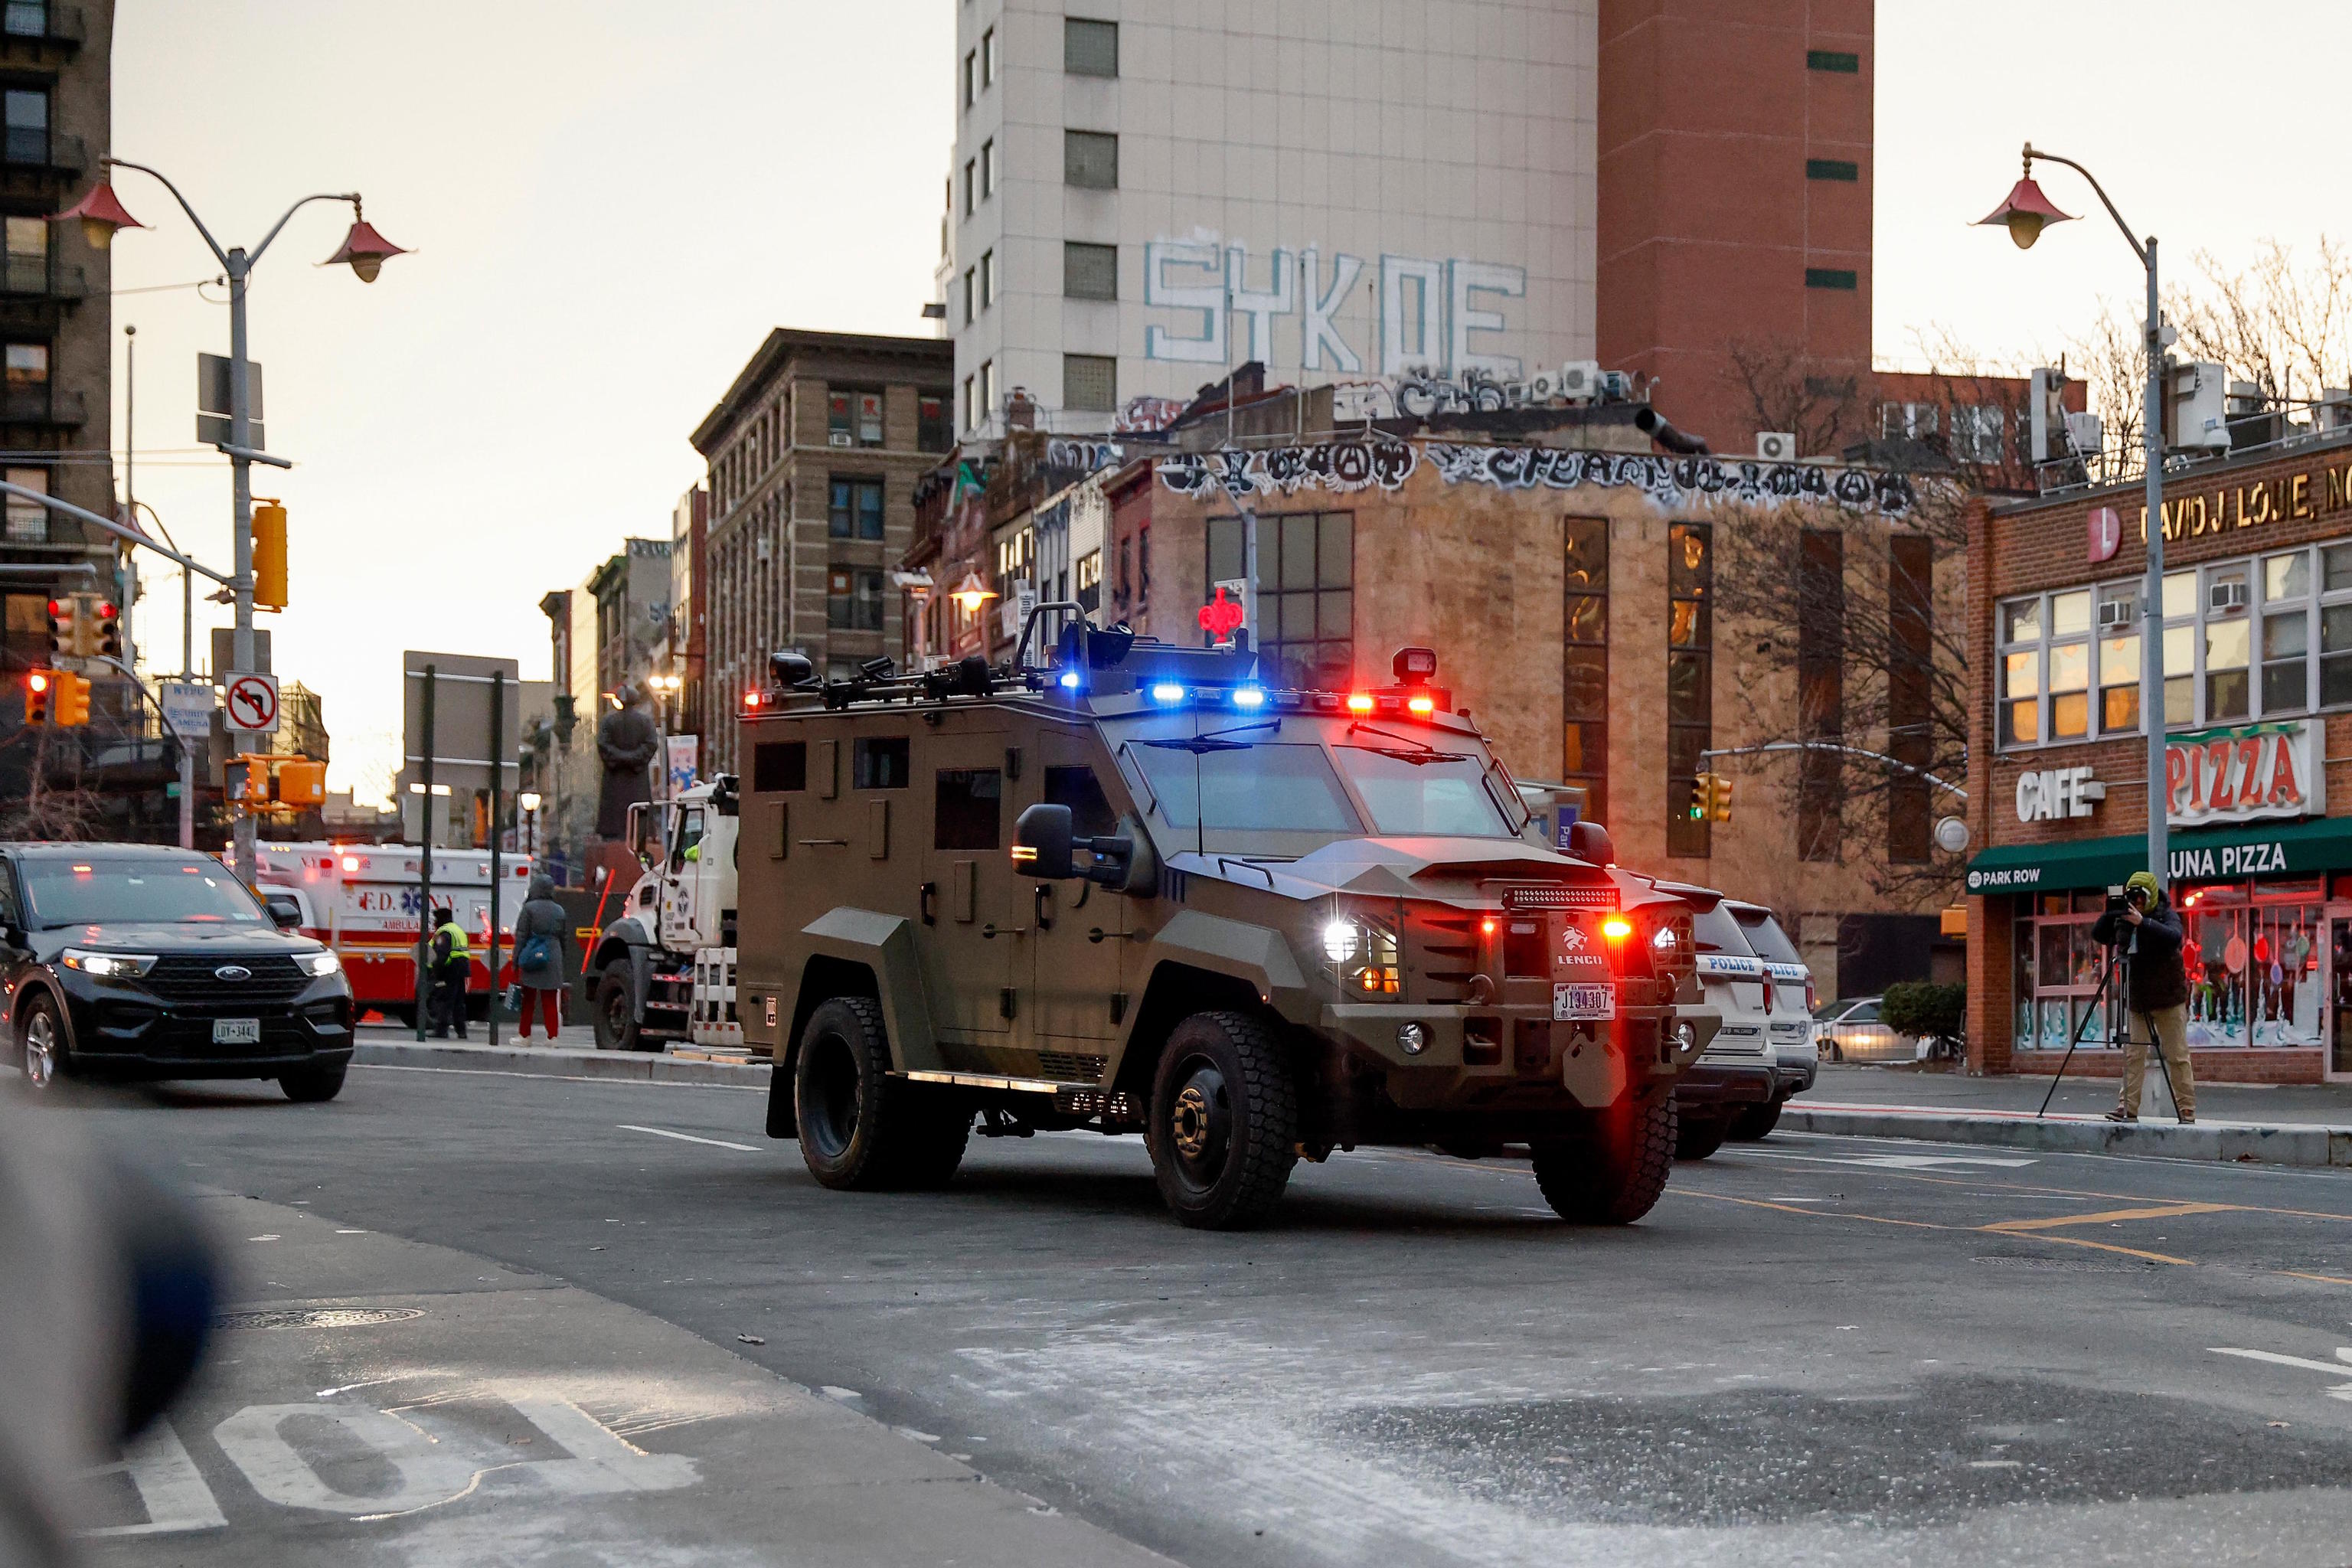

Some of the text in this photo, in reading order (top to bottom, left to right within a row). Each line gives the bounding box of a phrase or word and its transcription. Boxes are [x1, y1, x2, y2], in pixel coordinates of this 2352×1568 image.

[2165, 735, 2300, 813] PIZZA
[2016, 766, 2092, 822] CAFE
[2167, 842, 2287, 878] UNA PIZZA
[1983, 870, 2011, 886] PARK
[2013, 868, 2040, 884] ROW
[1708, 957, 1755, 972] POLICE
[1763, 964, 1798, 976] OLICE
